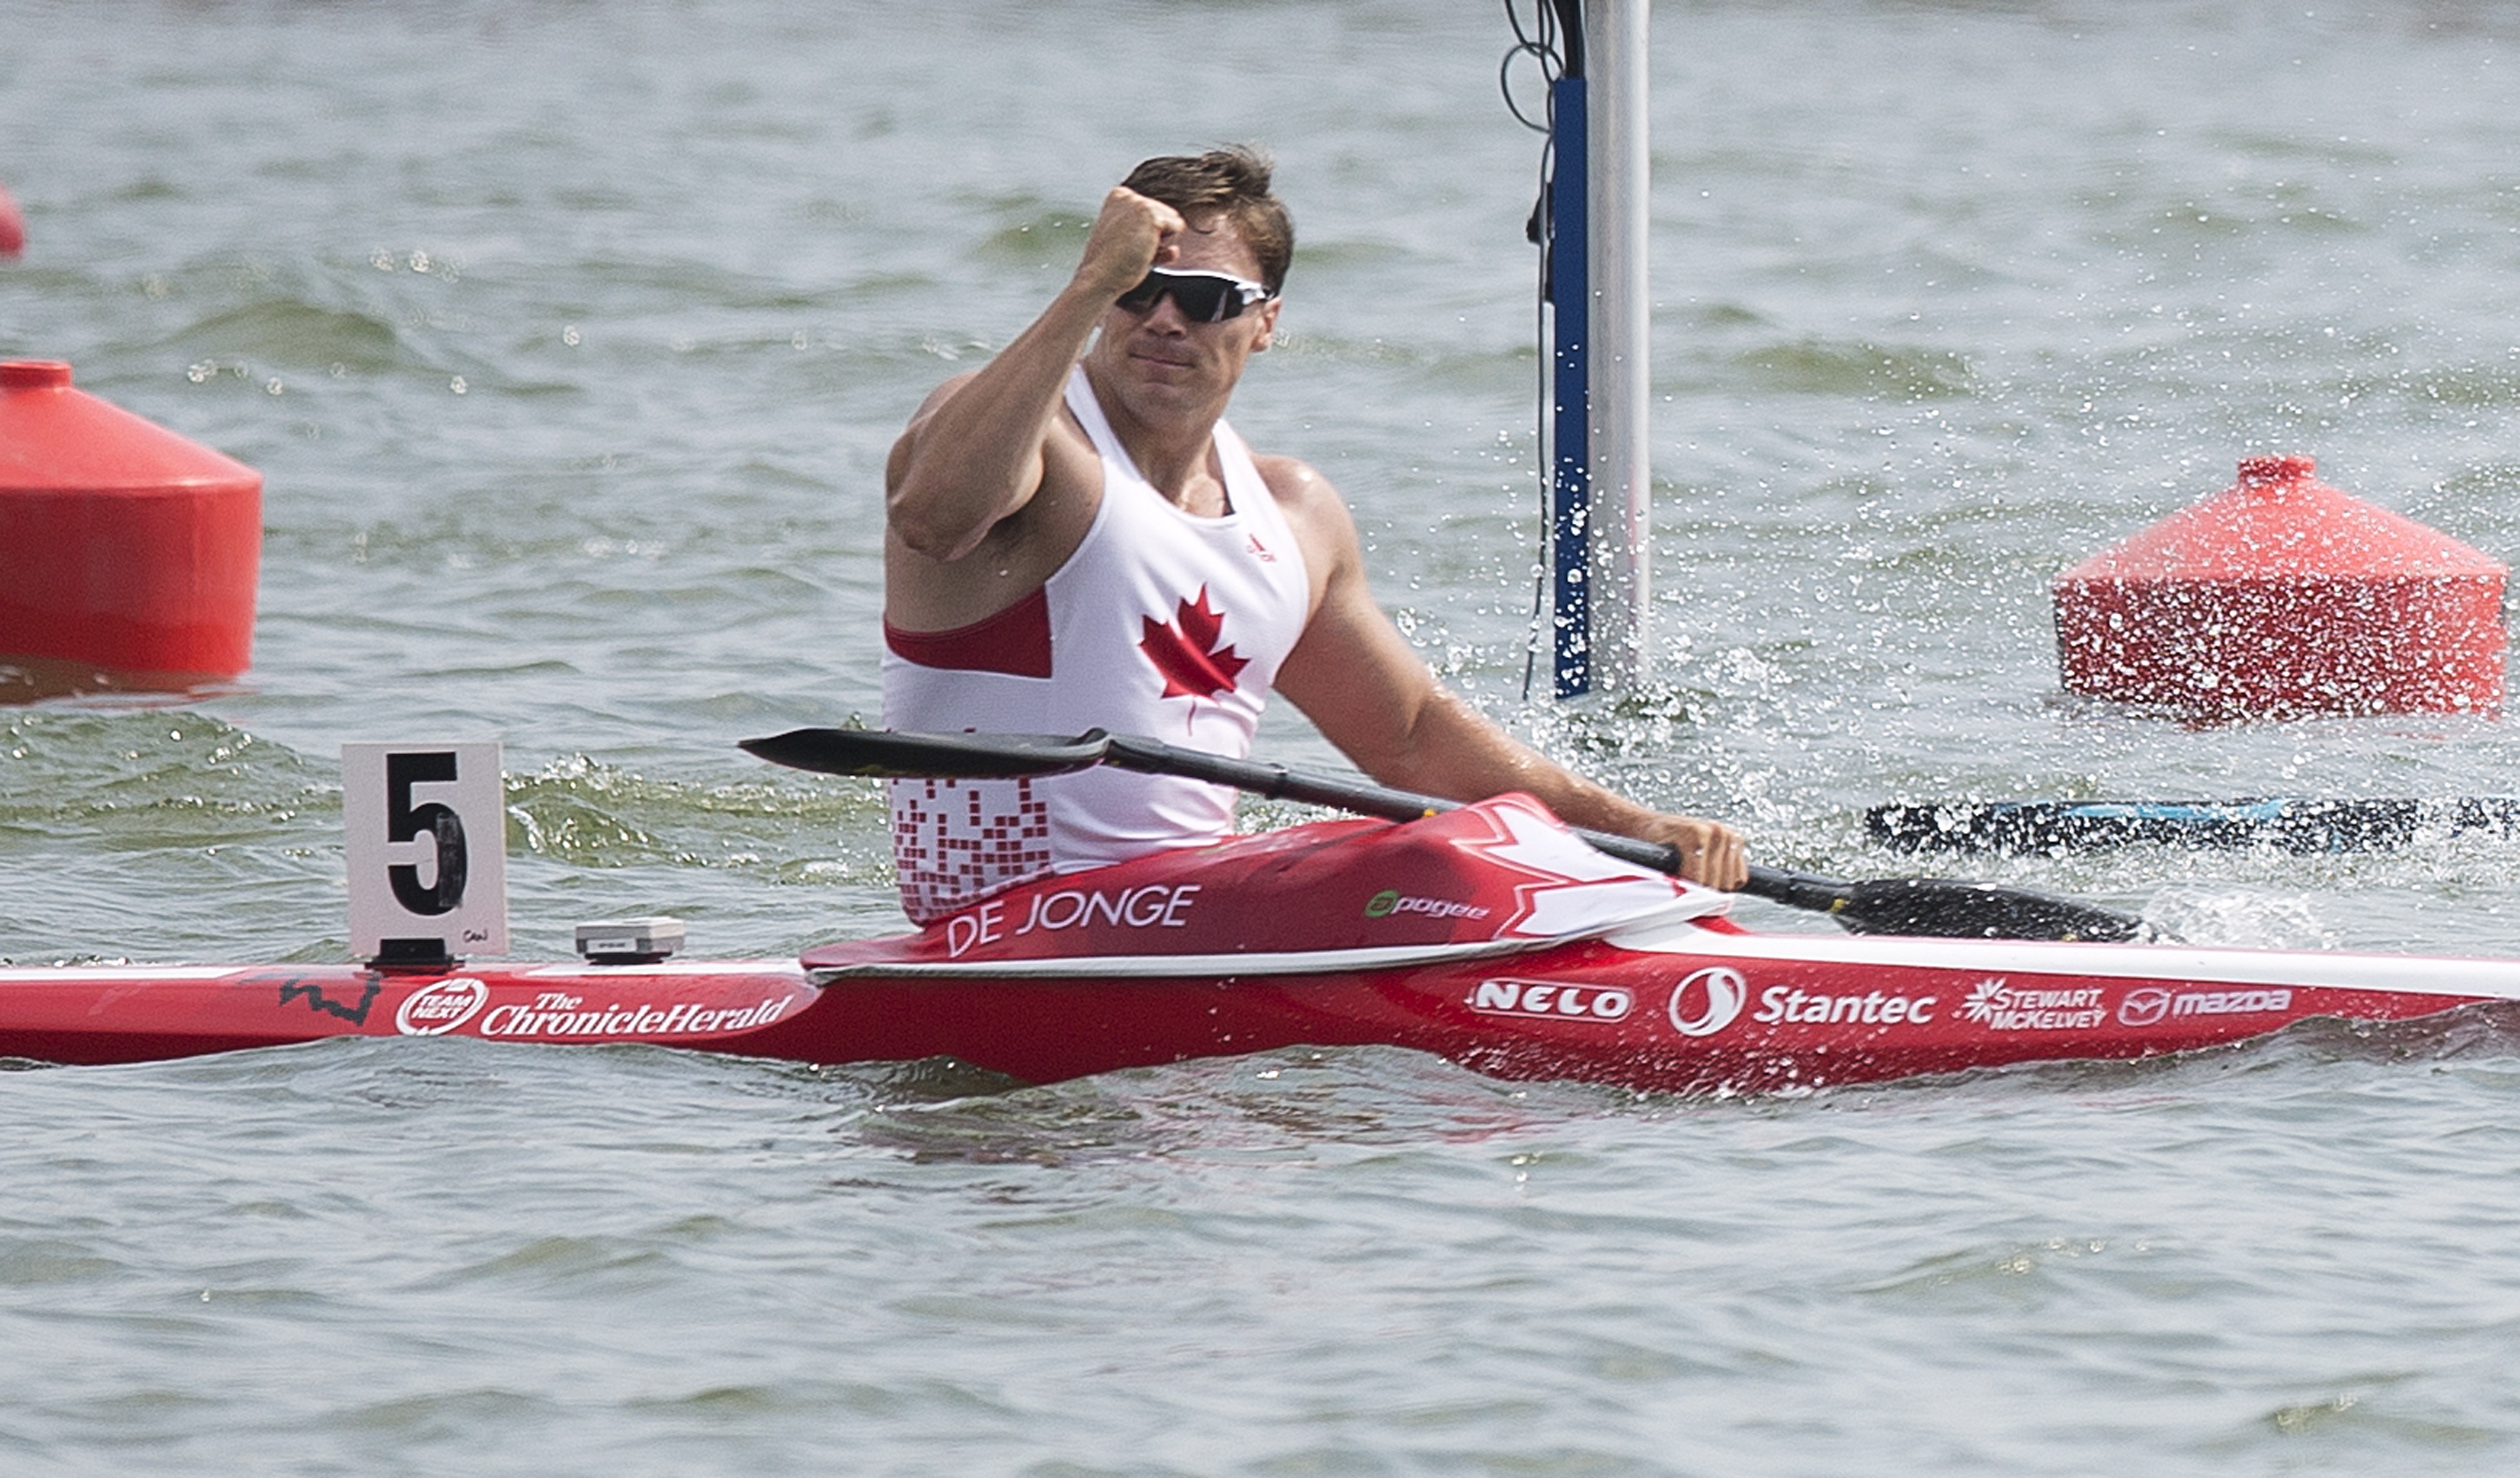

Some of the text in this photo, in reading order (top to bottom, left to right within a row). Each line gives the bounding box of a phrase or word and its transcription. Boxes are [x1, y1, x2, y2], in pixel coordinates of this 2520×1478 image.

[388, 752, 467, 915] 5
[947, 885, 1203, 958] DE JONGE
[411, 1007, 465, 1019] NEXT
[420, 994, 474, 1008] TEAM
[534, 992, 584, 1011] The
[1476, 981, 1630, 1018] NELO
[1753, 984, 1938, 1024] Stantec
[1991, 988, 2104, 1010] STEWART
